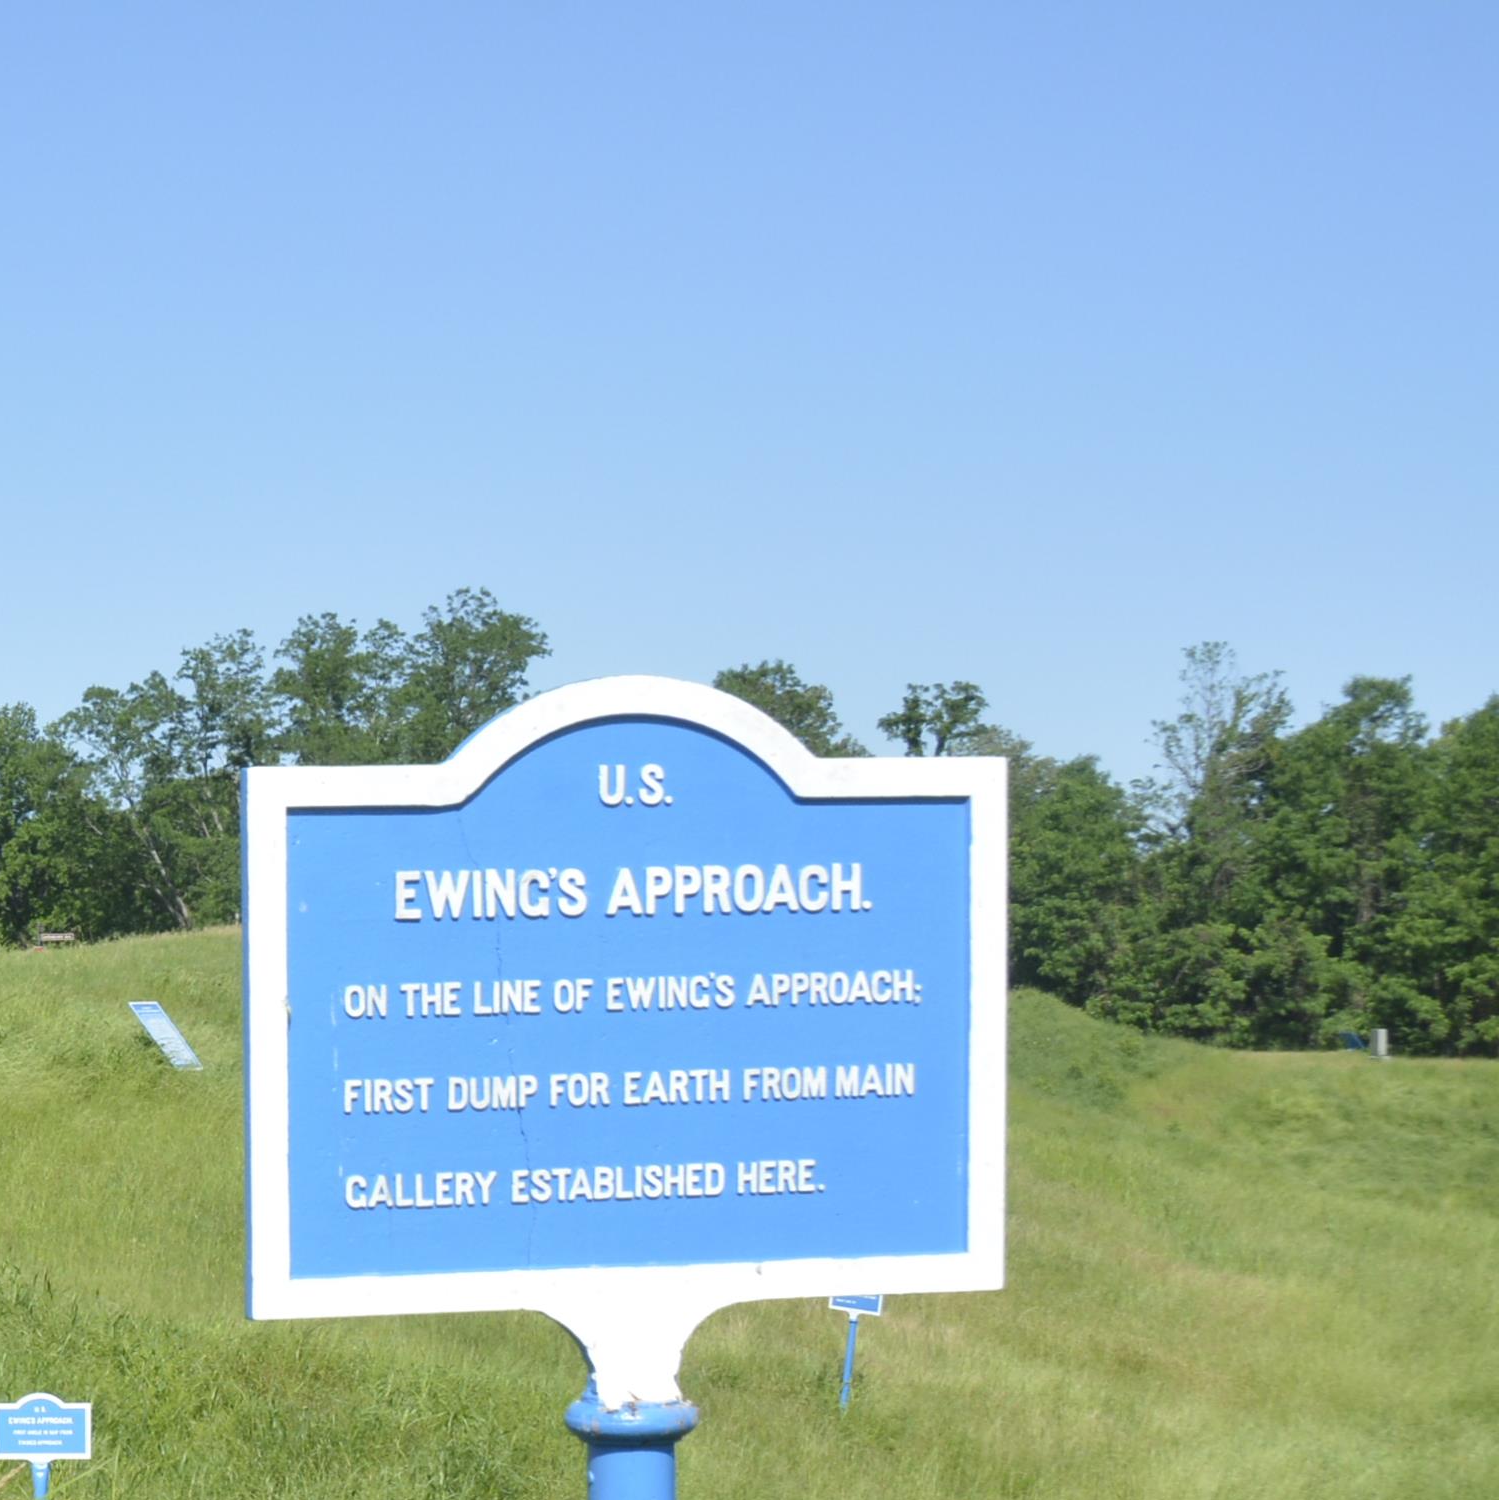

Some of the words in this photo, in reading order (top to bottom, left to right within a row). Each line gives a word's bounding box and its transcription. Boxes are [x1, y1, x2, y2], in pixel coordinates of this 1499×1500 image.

[597, 763, 674, 807] U.S.
[393, 868, 588, 922] EWING'S
[606, 863, 873, 917] APPROACH.
[344, 984, 388, 1018] ON
[400, 982, 462, 1018] THE
[473, 979, 542, 1016] LINE
[553, 978, 593, 1013] OF
[606, 973, 736, 1012] EWING'S
[343, 1078, 434, 1115] FIRST
[447, 1074, 538, 1111] DUMP
[549, 1072, 610, 1108] FOR
[623, 1069, 730, 1106] EARTH
[743, 1065, 827, 1102] FROM
[834, 1063, 916, 1099] MAIN
[345, 1171, 497, 1209] GALLERY
[511, 1163, 725, 1204] ESTABLISHED
[737, 1160, 826, 1195] HERE.
